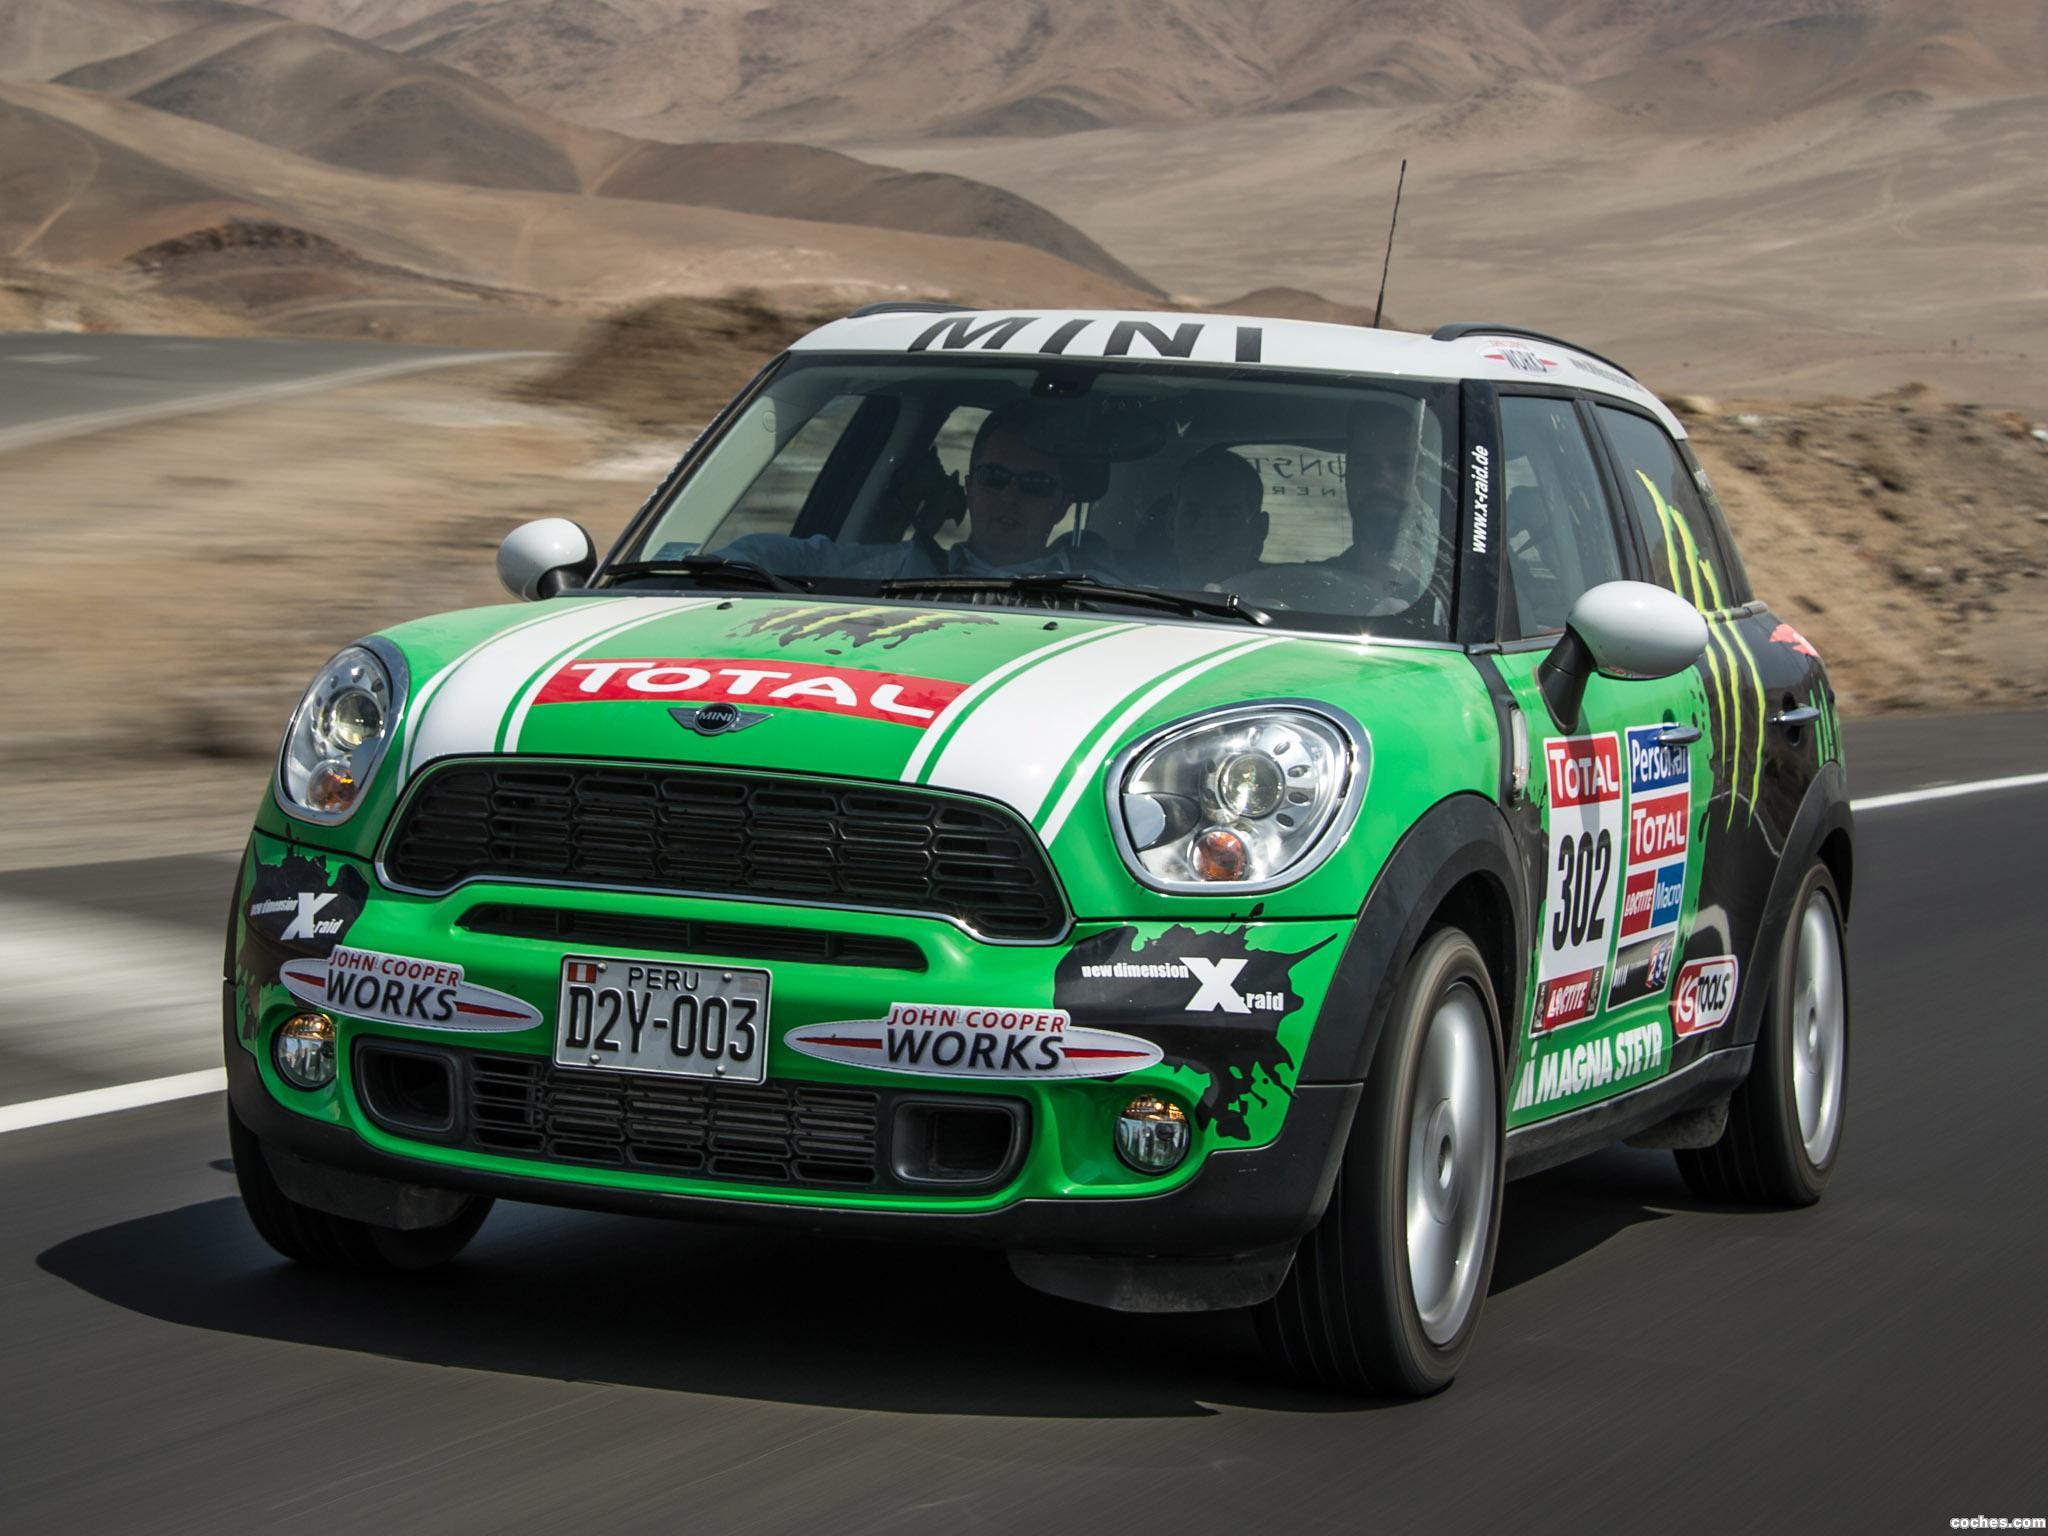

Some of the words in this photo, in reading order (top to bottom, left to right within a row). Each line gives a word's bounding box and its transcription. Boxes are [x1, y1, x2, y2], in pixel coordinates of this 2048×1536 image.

[908, 316, 1262, 363] MINI
[1472, 445, 1488, 554] www.x-raid.de
[699, 712, 733, 722] MINI
[1553, 828, 1611, 951] 302
[329, 951, 376, 971] JOHN
[381, 958, 459, 986] COOPER
[628, 967, 699, 991] PERU
[1081, 965, 1112, 978] new
[1113, 962, 1190, 979] dimension
[326, 969, 457, 1021] WORKS
[566, 987, 758, 1061] D2Y-003
[887, 1008, 956, 1027] JOHN
[966, 1011, 1064, 1033] COOPER
[887, 1028, 1063, 1071] WORKS
[1534, 1036, 1613, 1104] MAGNA
[1615, 1021, 1663, 1081] STEYR
